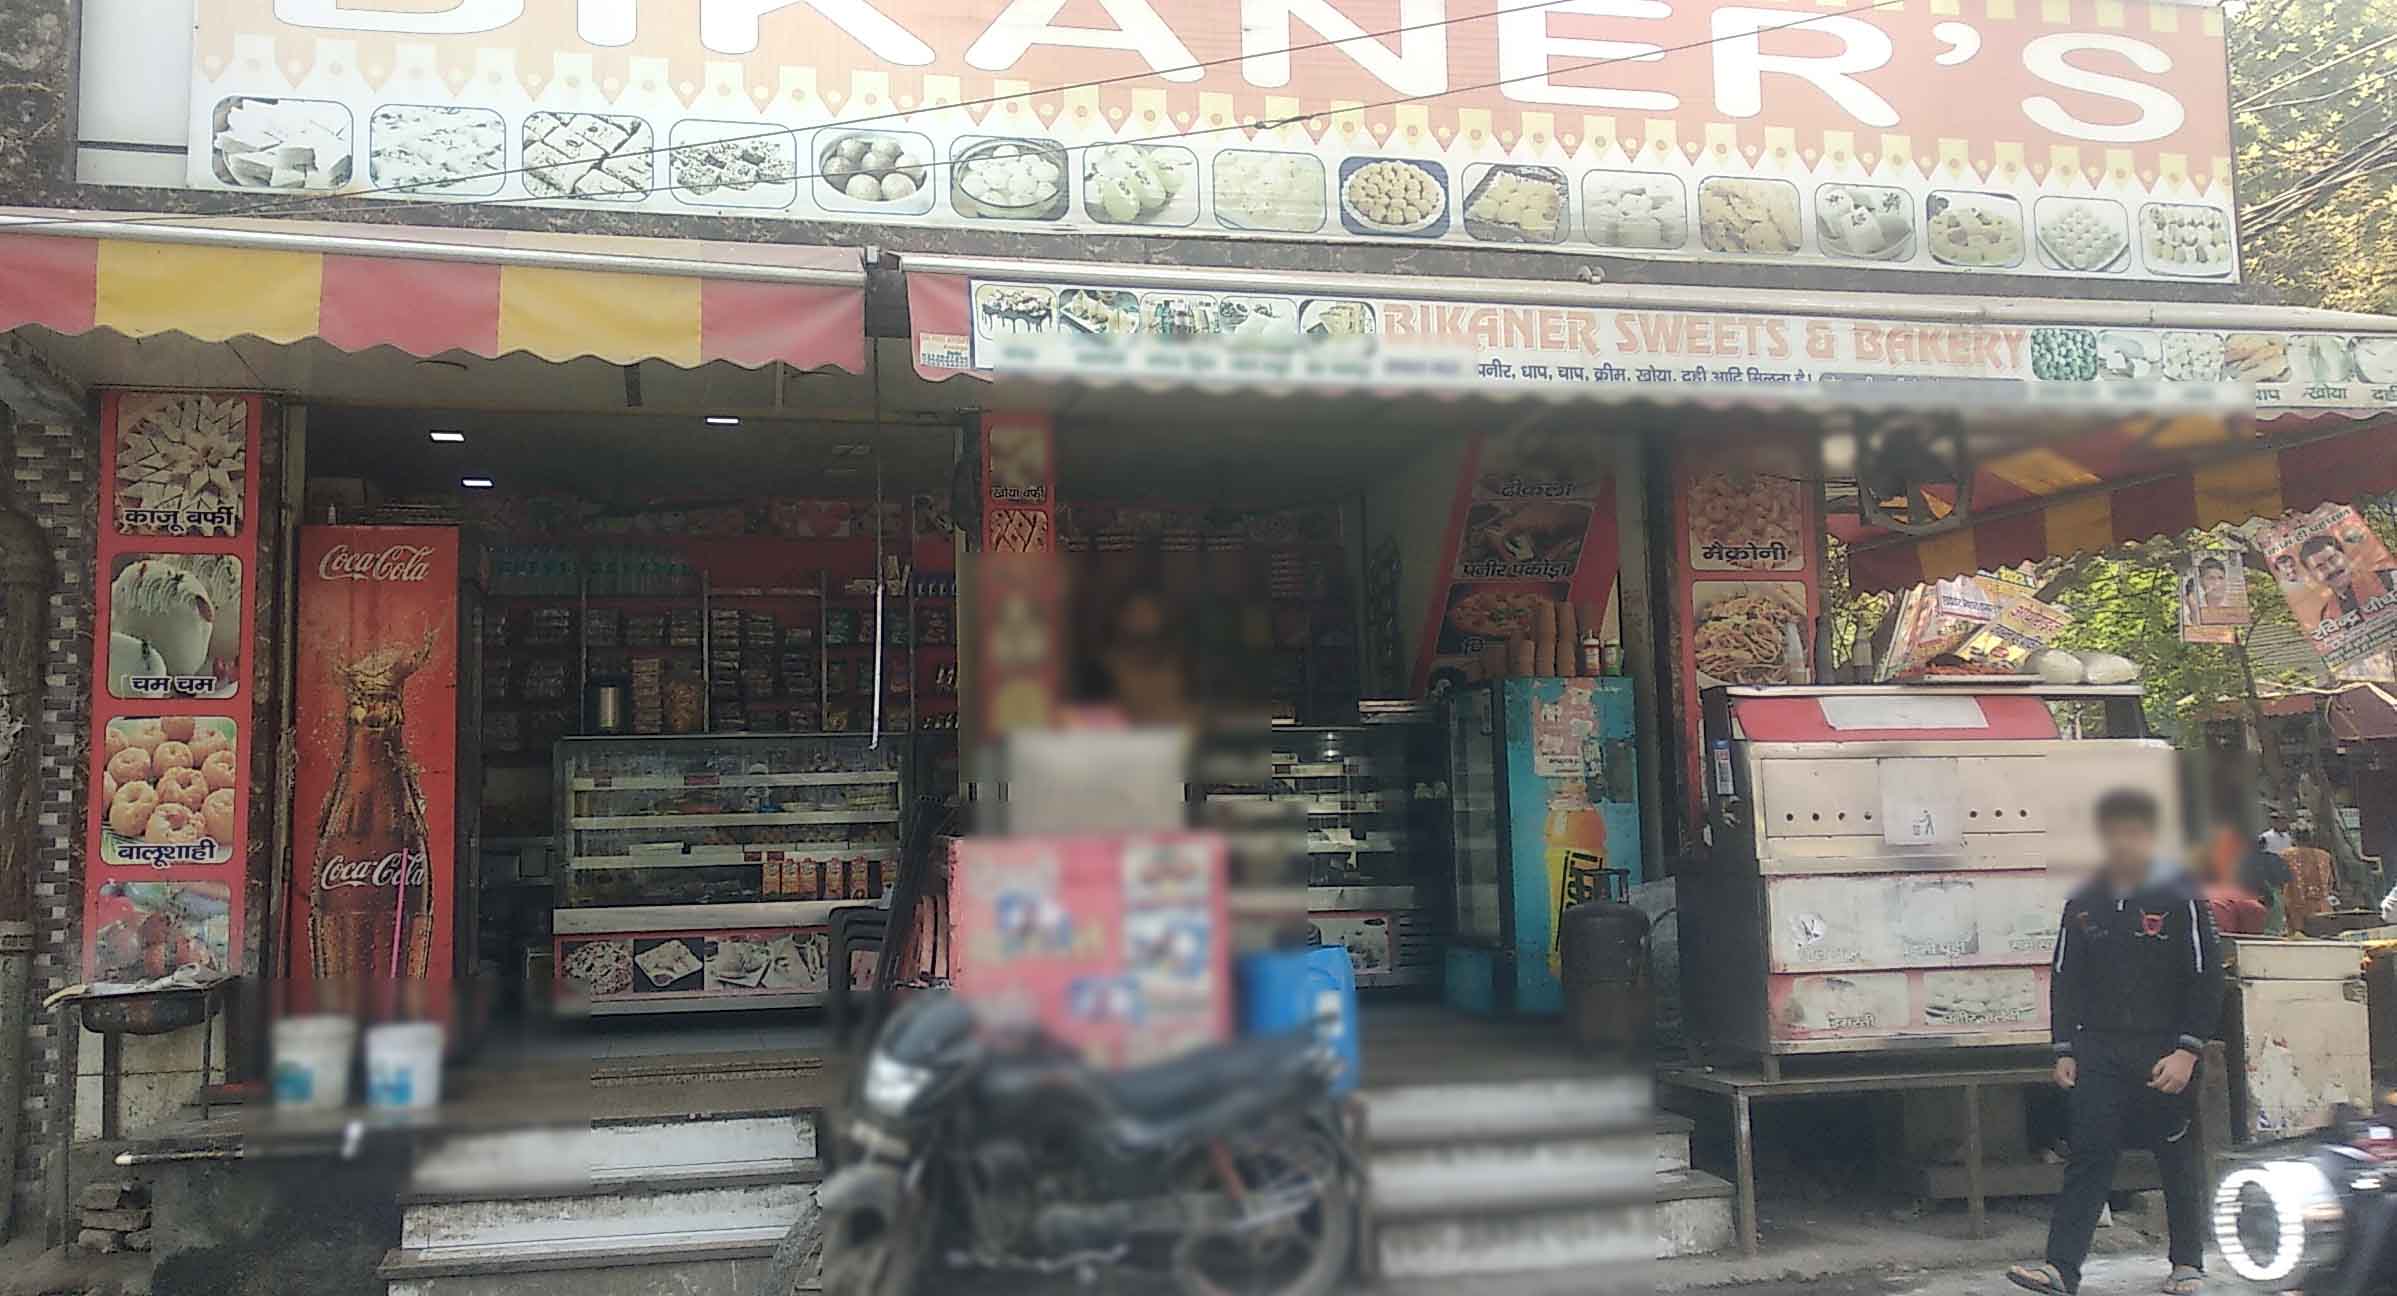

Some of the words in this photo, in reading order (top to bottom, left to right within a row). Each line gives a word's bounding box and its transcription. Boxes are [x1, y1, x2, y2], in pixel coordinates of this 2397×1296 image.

[274, 0, 2185, 143] ANER'S
[1383, 303, 1601, 358] BIKANER
[1615, 312, 1789, 360] SWEETS
[1805, 320, 1836, 362] &
[1854, 325, 2027, 370] BAKERY
[124, 509, 185, 532] काजू
[318, 543, 436, 583] Coca-Cola
[131, 676, 170, 693] चम
[174, 676, 216, 693] चम
